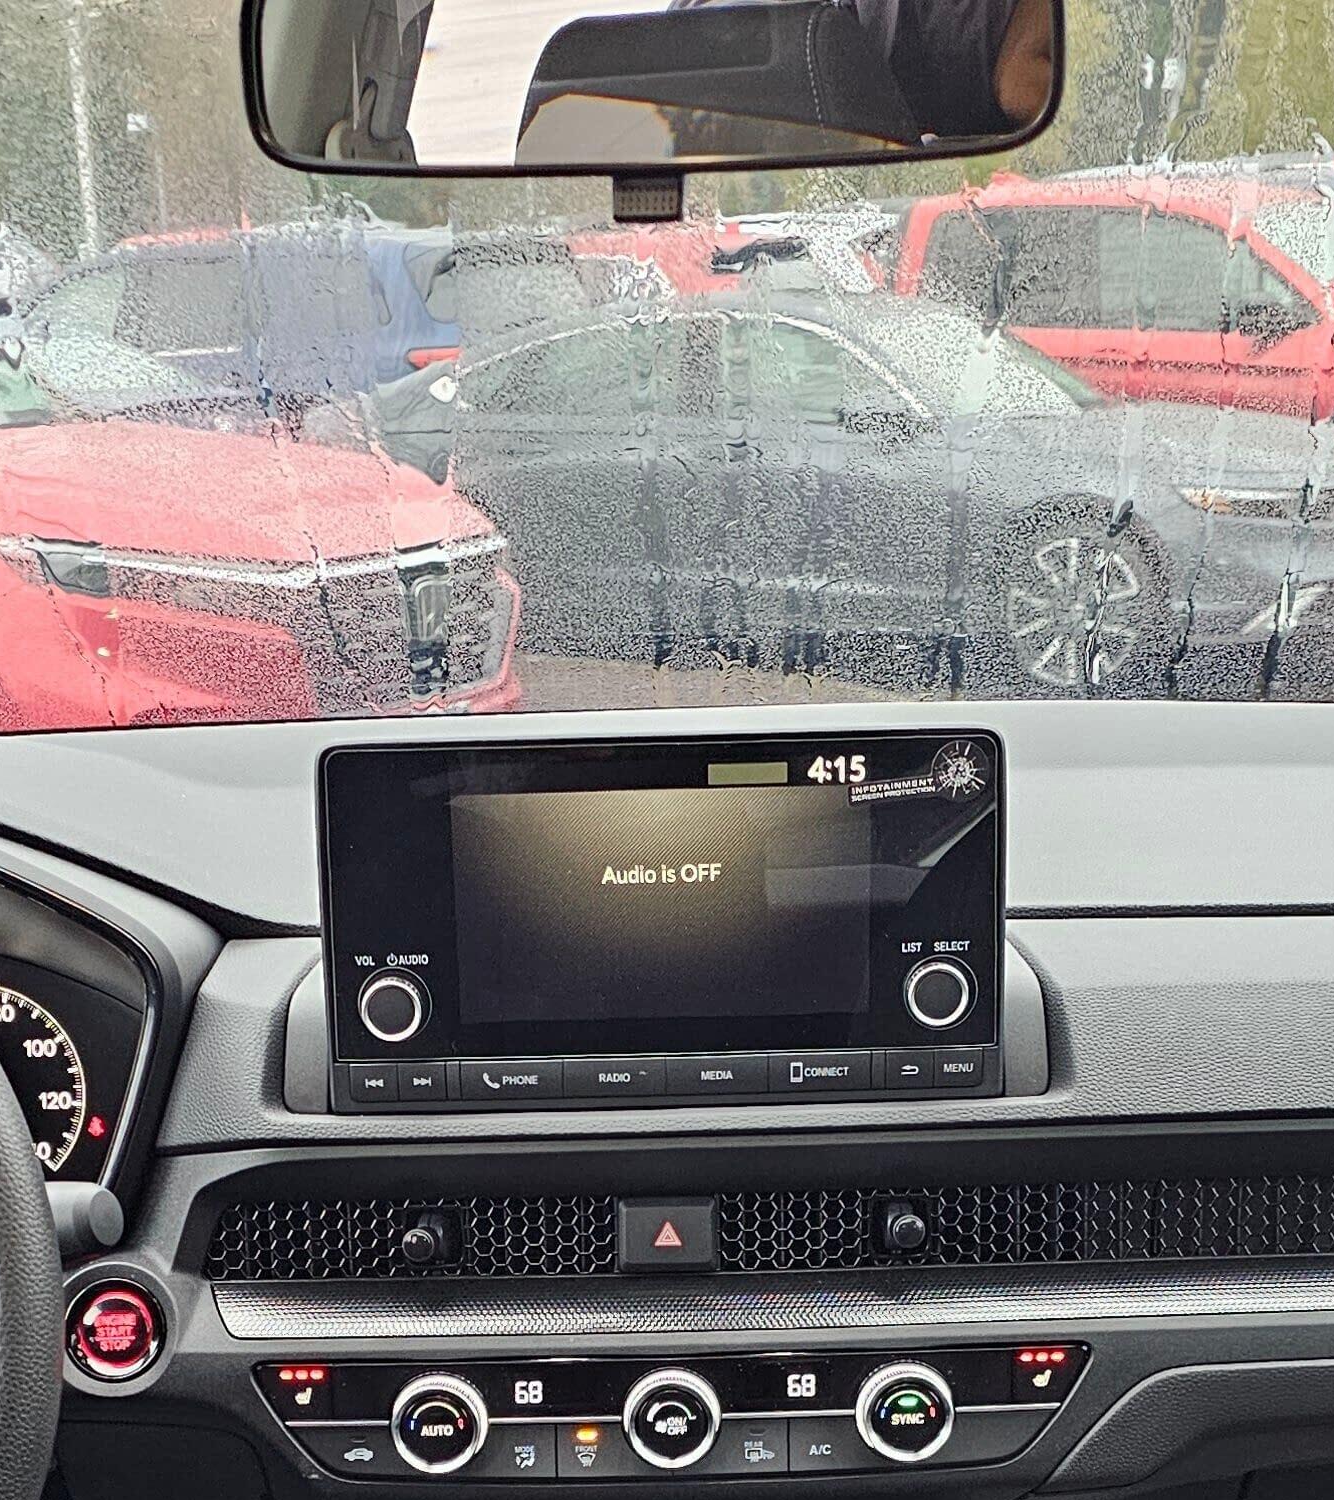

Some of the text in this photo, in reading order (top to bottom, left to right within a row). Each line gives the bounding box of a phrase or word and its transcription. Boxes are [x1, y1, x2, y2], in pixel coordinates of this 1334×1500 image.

[807, 755, 866, 784] 4:15
[884, 786, 936, 798] PROTECTION
[601, 862, 722, 885] Audio is OFF
[901, 942, 922, 953] LIST
[933, 940, 970, 952] SELECT
[354, 956, 375, 967] VOL
[398, 954, 429, 966] AUDIO
[23, 1039, 57, 1058] 100
[804, 1066, 849, 1078] CONNECT
[943, 1062, 974, 1074] MENU
[502, 1074, 539, 1086] PHONE
[598, 1072, 631, 1083] RADIO
[700, 1070, 733, 1081] MEDIA
[38, 1091, 72, 1110] 120
[100, 1340, 131, 1352] STOP
[786, 1373, 815, 1398] 68
[513, 1380, 543, 1404] 68
[891, 1413, 925, 1425] SYNC
[420, 1424, 454, 1438] AUTO
[667, 1425, 687, 1436] OFF
[809, 1444, 832, 1456] A/C
